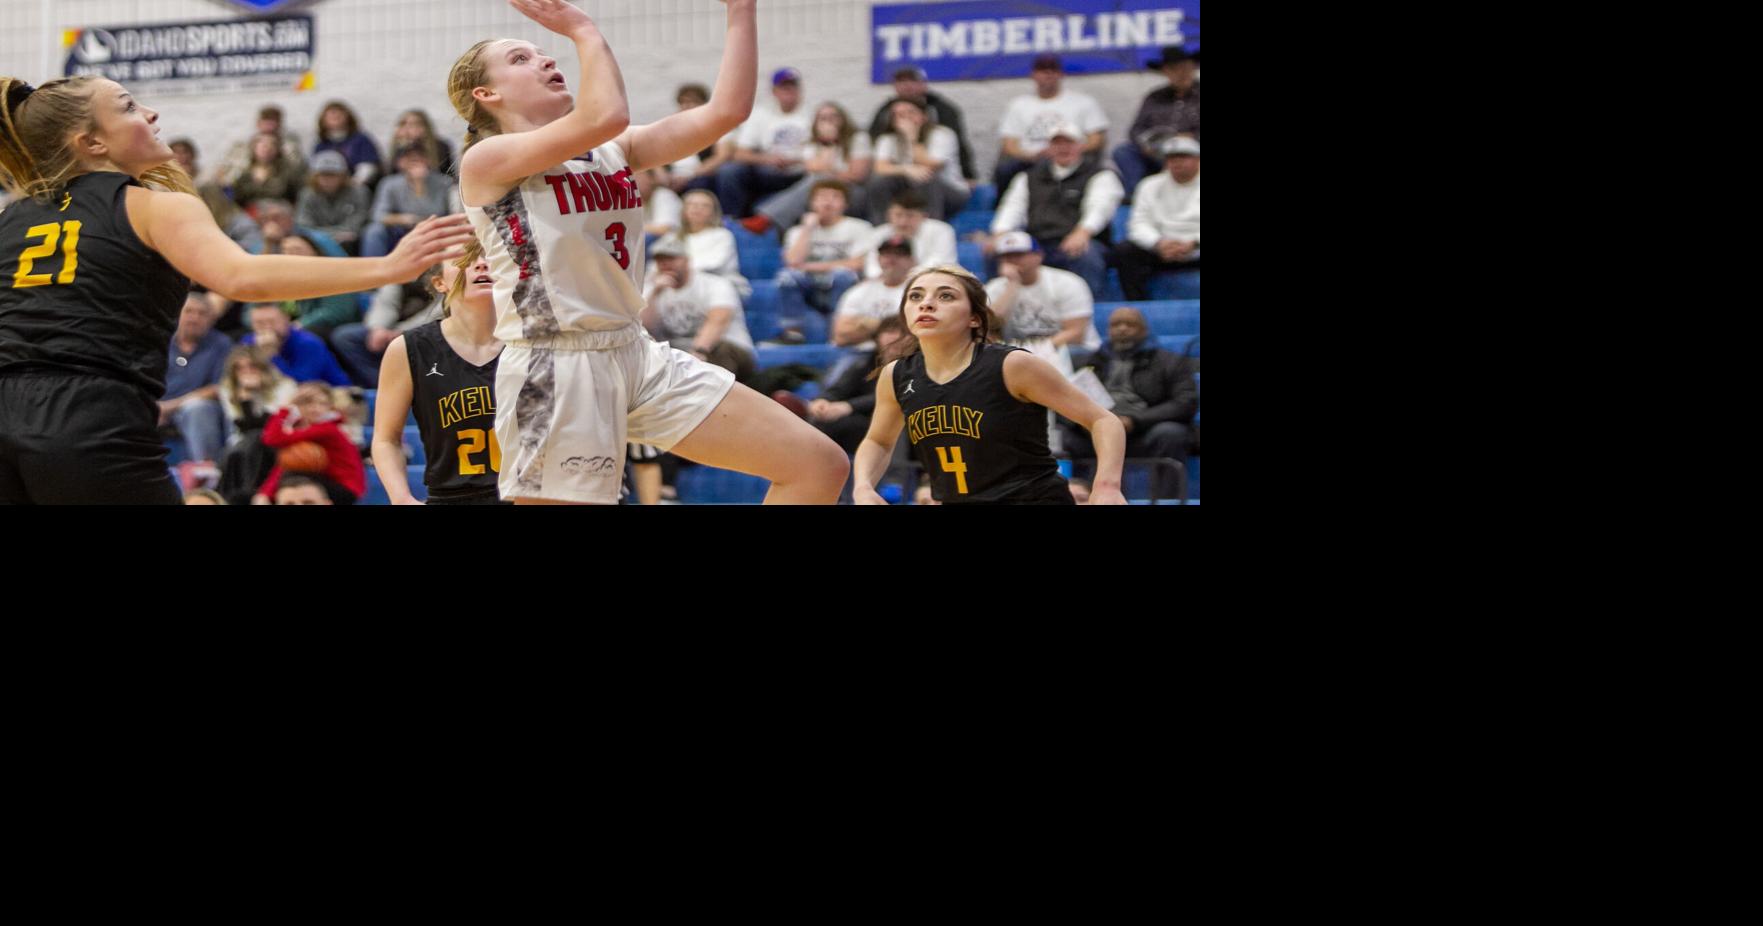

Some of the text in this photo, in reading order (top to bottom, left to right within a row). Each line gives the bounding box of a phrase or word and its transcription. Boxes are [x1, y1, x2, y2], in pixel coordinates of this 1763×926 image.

[877, 9, 1184, 60] TIMBERLINE
[12, 220, 82, 289] 21
[605, 222, 630, 270] 3
[908, 404, 984, 445] KELLY
[935, 446, 968, 494] 4
